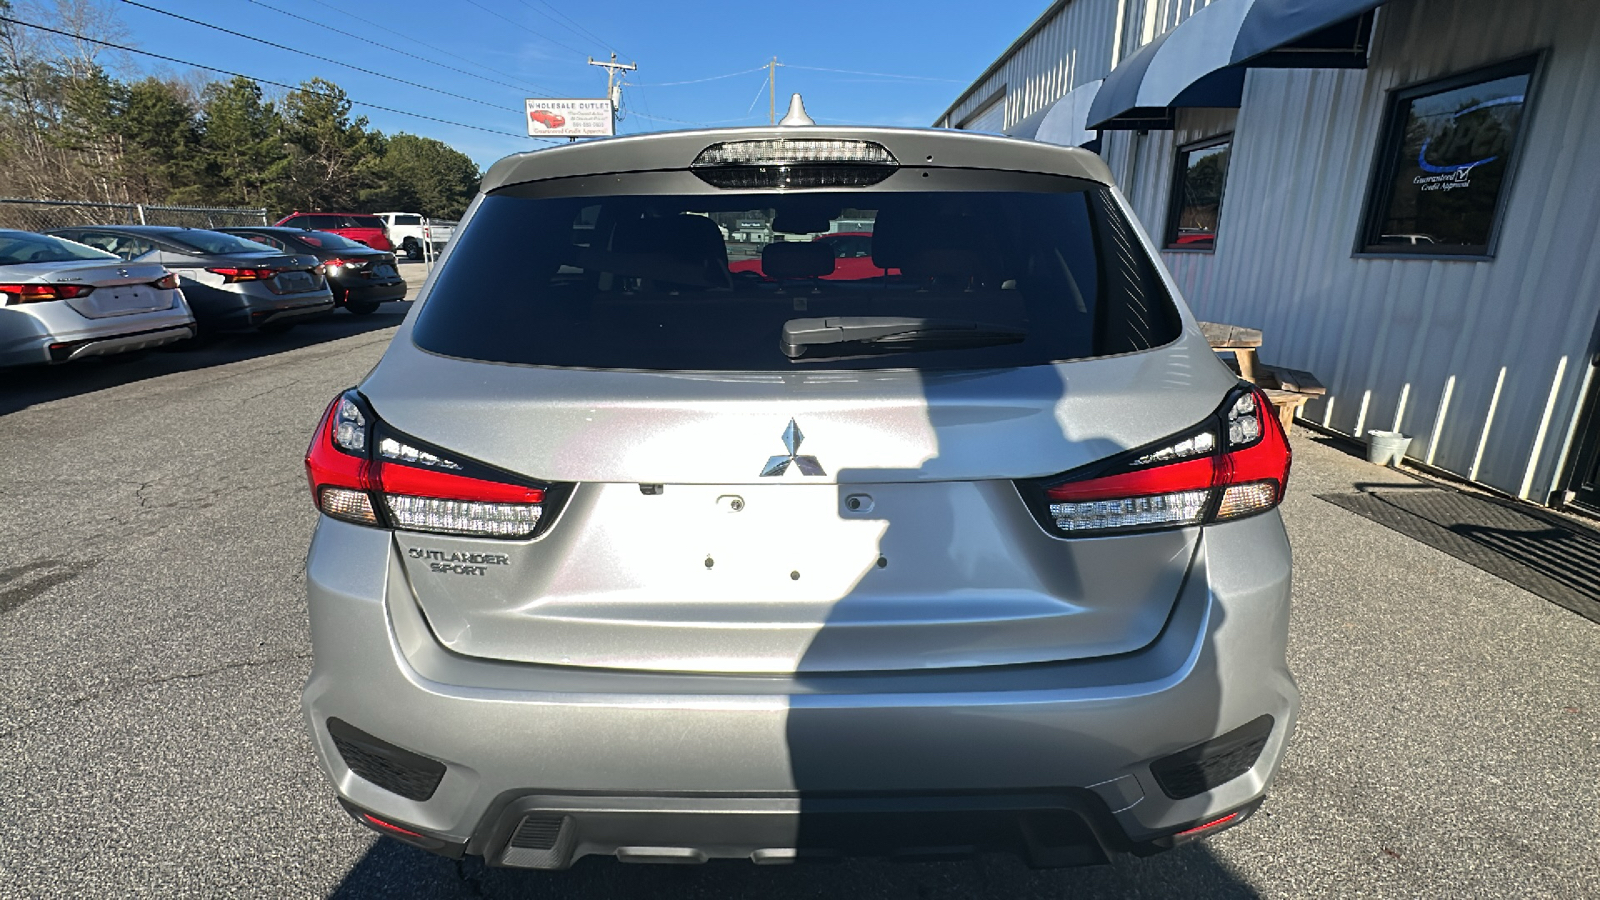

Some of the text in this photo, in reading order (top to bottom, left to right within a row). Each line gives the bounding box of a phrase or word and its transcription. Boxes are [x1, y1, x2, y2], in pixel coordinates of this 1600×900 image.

[1413, 171, 1456, 184] Guaranteed
[1421, 180, 1471, 192] Credit Approval
[408, 547, 510, 565] OUTLANDER
[430, 562, 488, 576] SPORT
